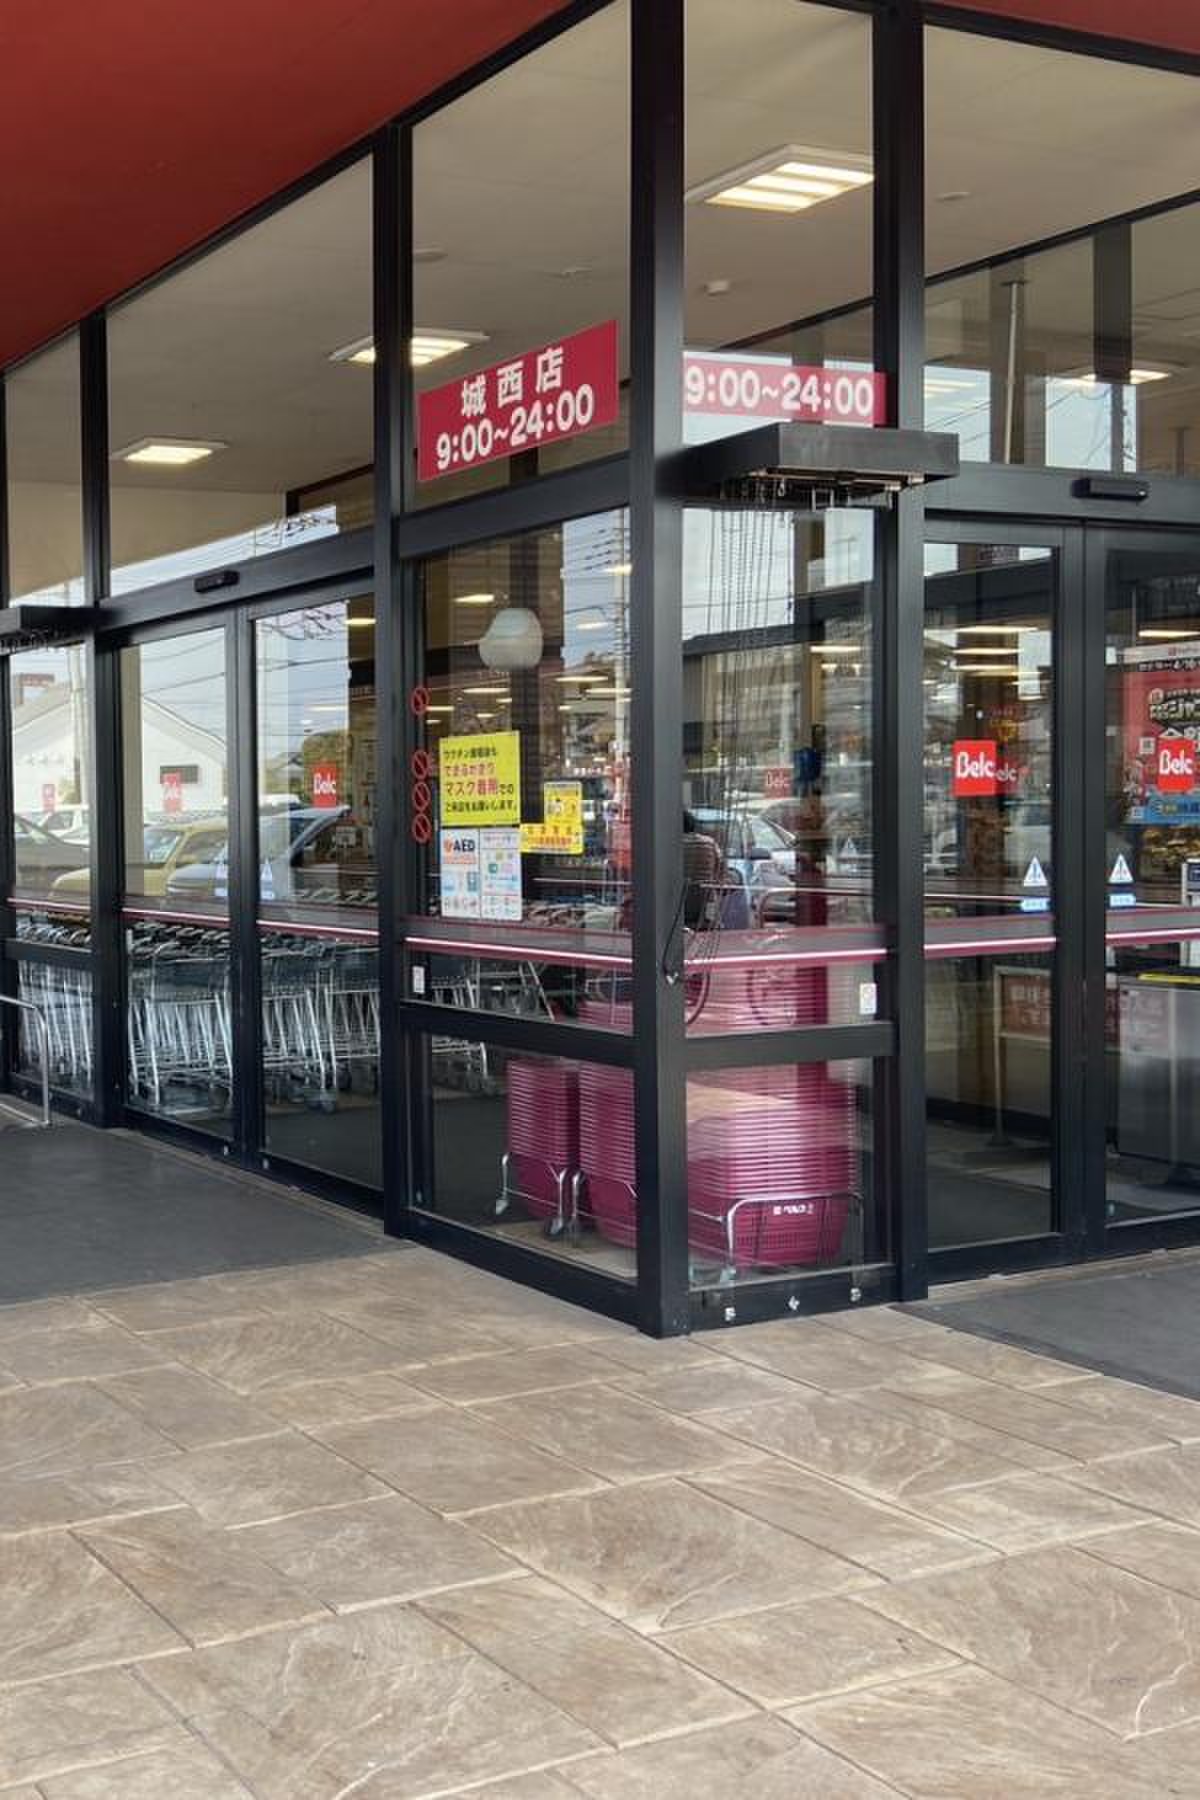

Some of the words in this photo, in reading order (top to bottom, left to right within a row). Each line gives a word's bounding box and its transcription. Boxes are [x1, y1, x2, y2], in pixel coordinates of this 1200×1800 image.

[459, 347, 565, 417] 城西店
[955, 751, 995, 779] Belc
[1158, 749, 1193, 775] Belc
[313, 772, 337, 795] Belc
[453, 839, 475, 852] AED
